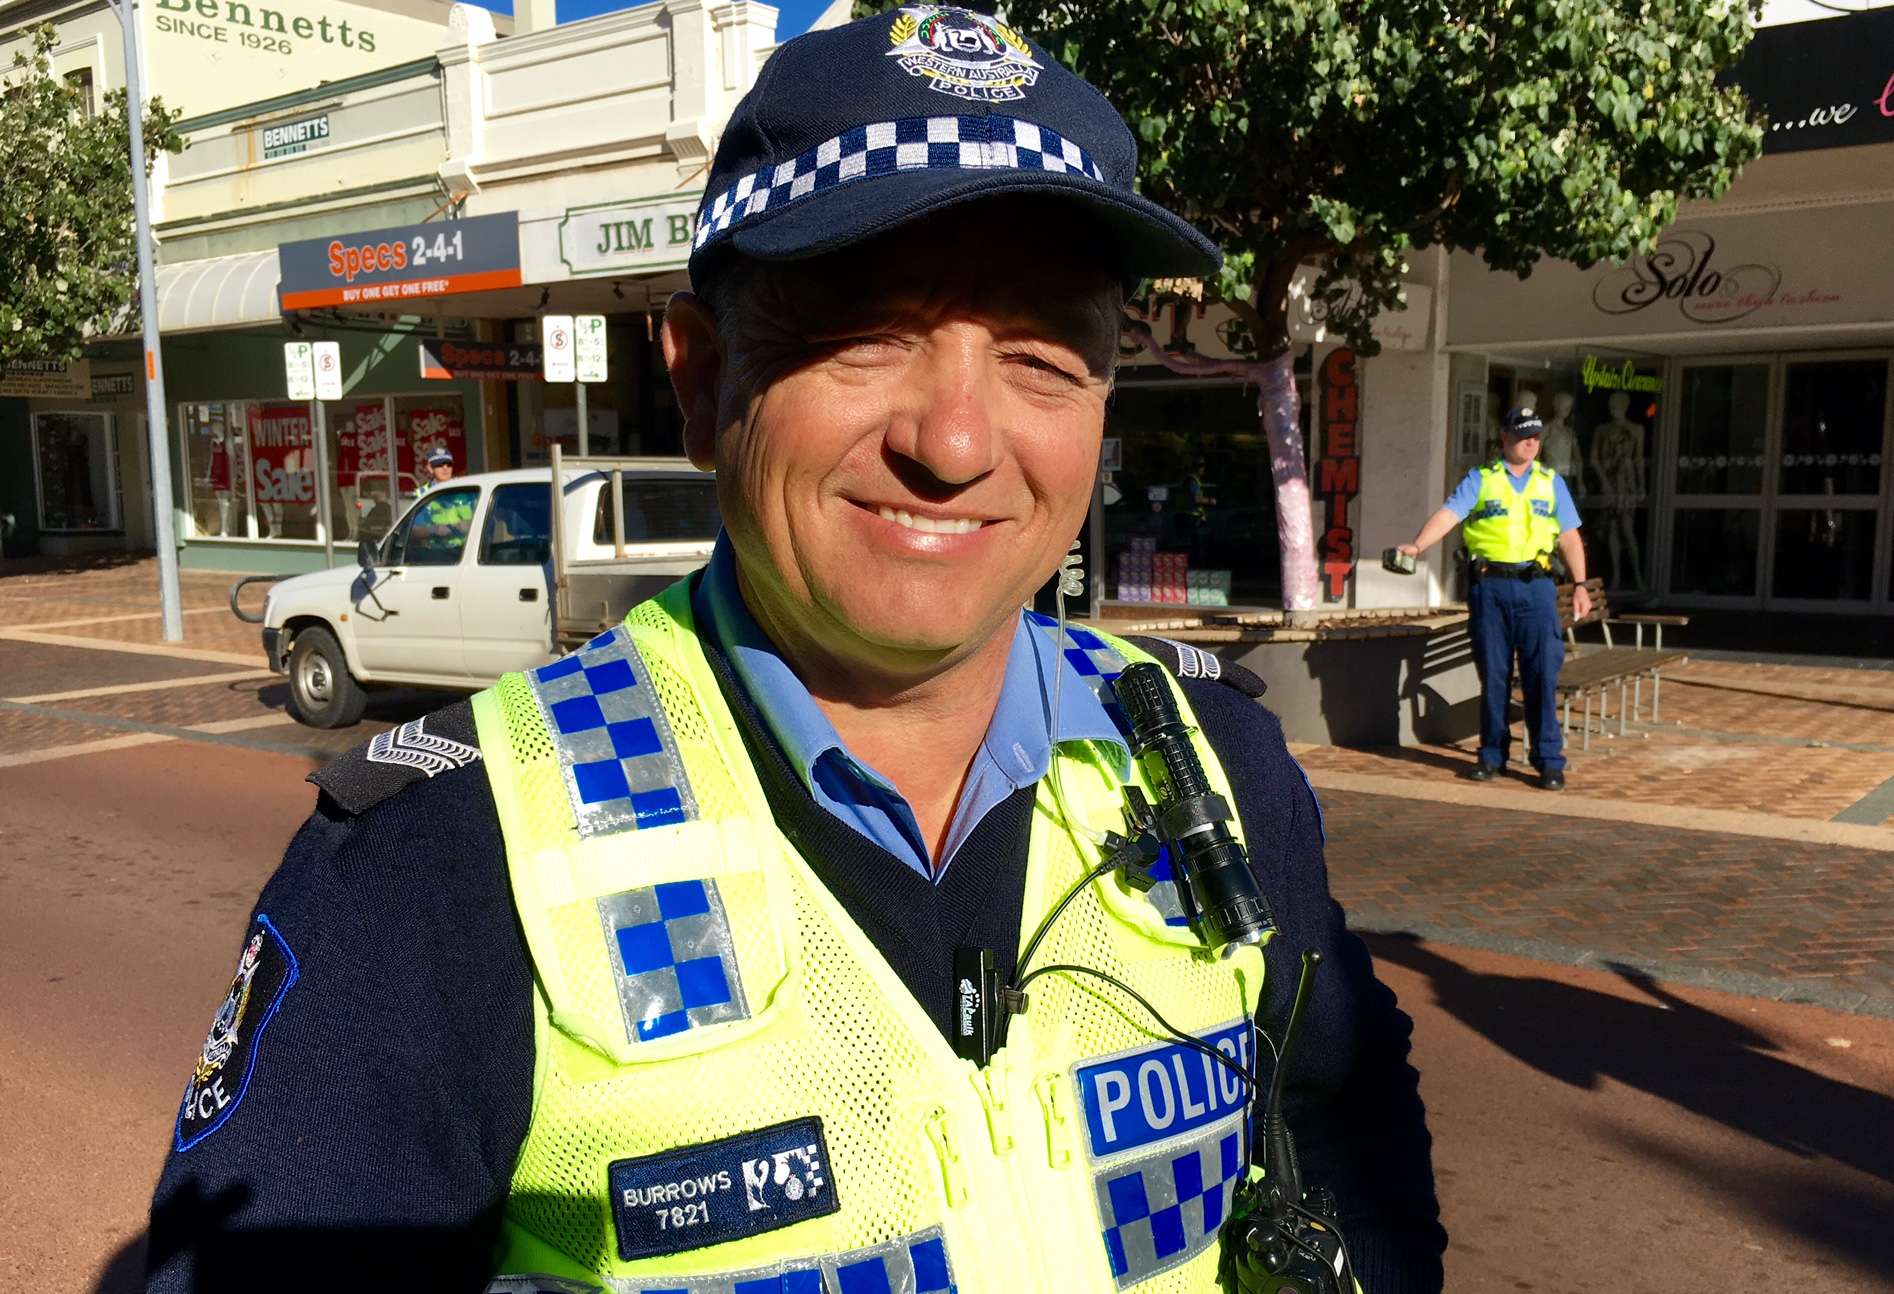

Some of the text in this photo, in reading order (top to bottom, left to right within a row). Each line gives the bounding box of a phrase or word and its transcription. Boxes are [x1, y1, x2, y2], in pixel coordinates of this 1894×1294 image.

[156, 15, 292, 55] SINCE 1926
[904, 55, 1035, 80] WESTERN AUSTRALIA
[939, 80, 1017, 99] POLICE
[264, 116, 329, 148] BENNETTS
[597, 213, 697, 254] JIM B
[329, 230, 463, 282] Specs 2-4-1
[343, 288, 361, 301] BUY
[363, 286, 381, 299] ONE
[382, 284, 400, 296] GET
[402, 282, 421, 295] ONE
[252, 416, 310, 448] WINTER
[1320, 346, 1359, 598] CHEMIST
[623, 1170, 732, 1208] BURROWS
[656, 1201, 711, 1231] 7821
